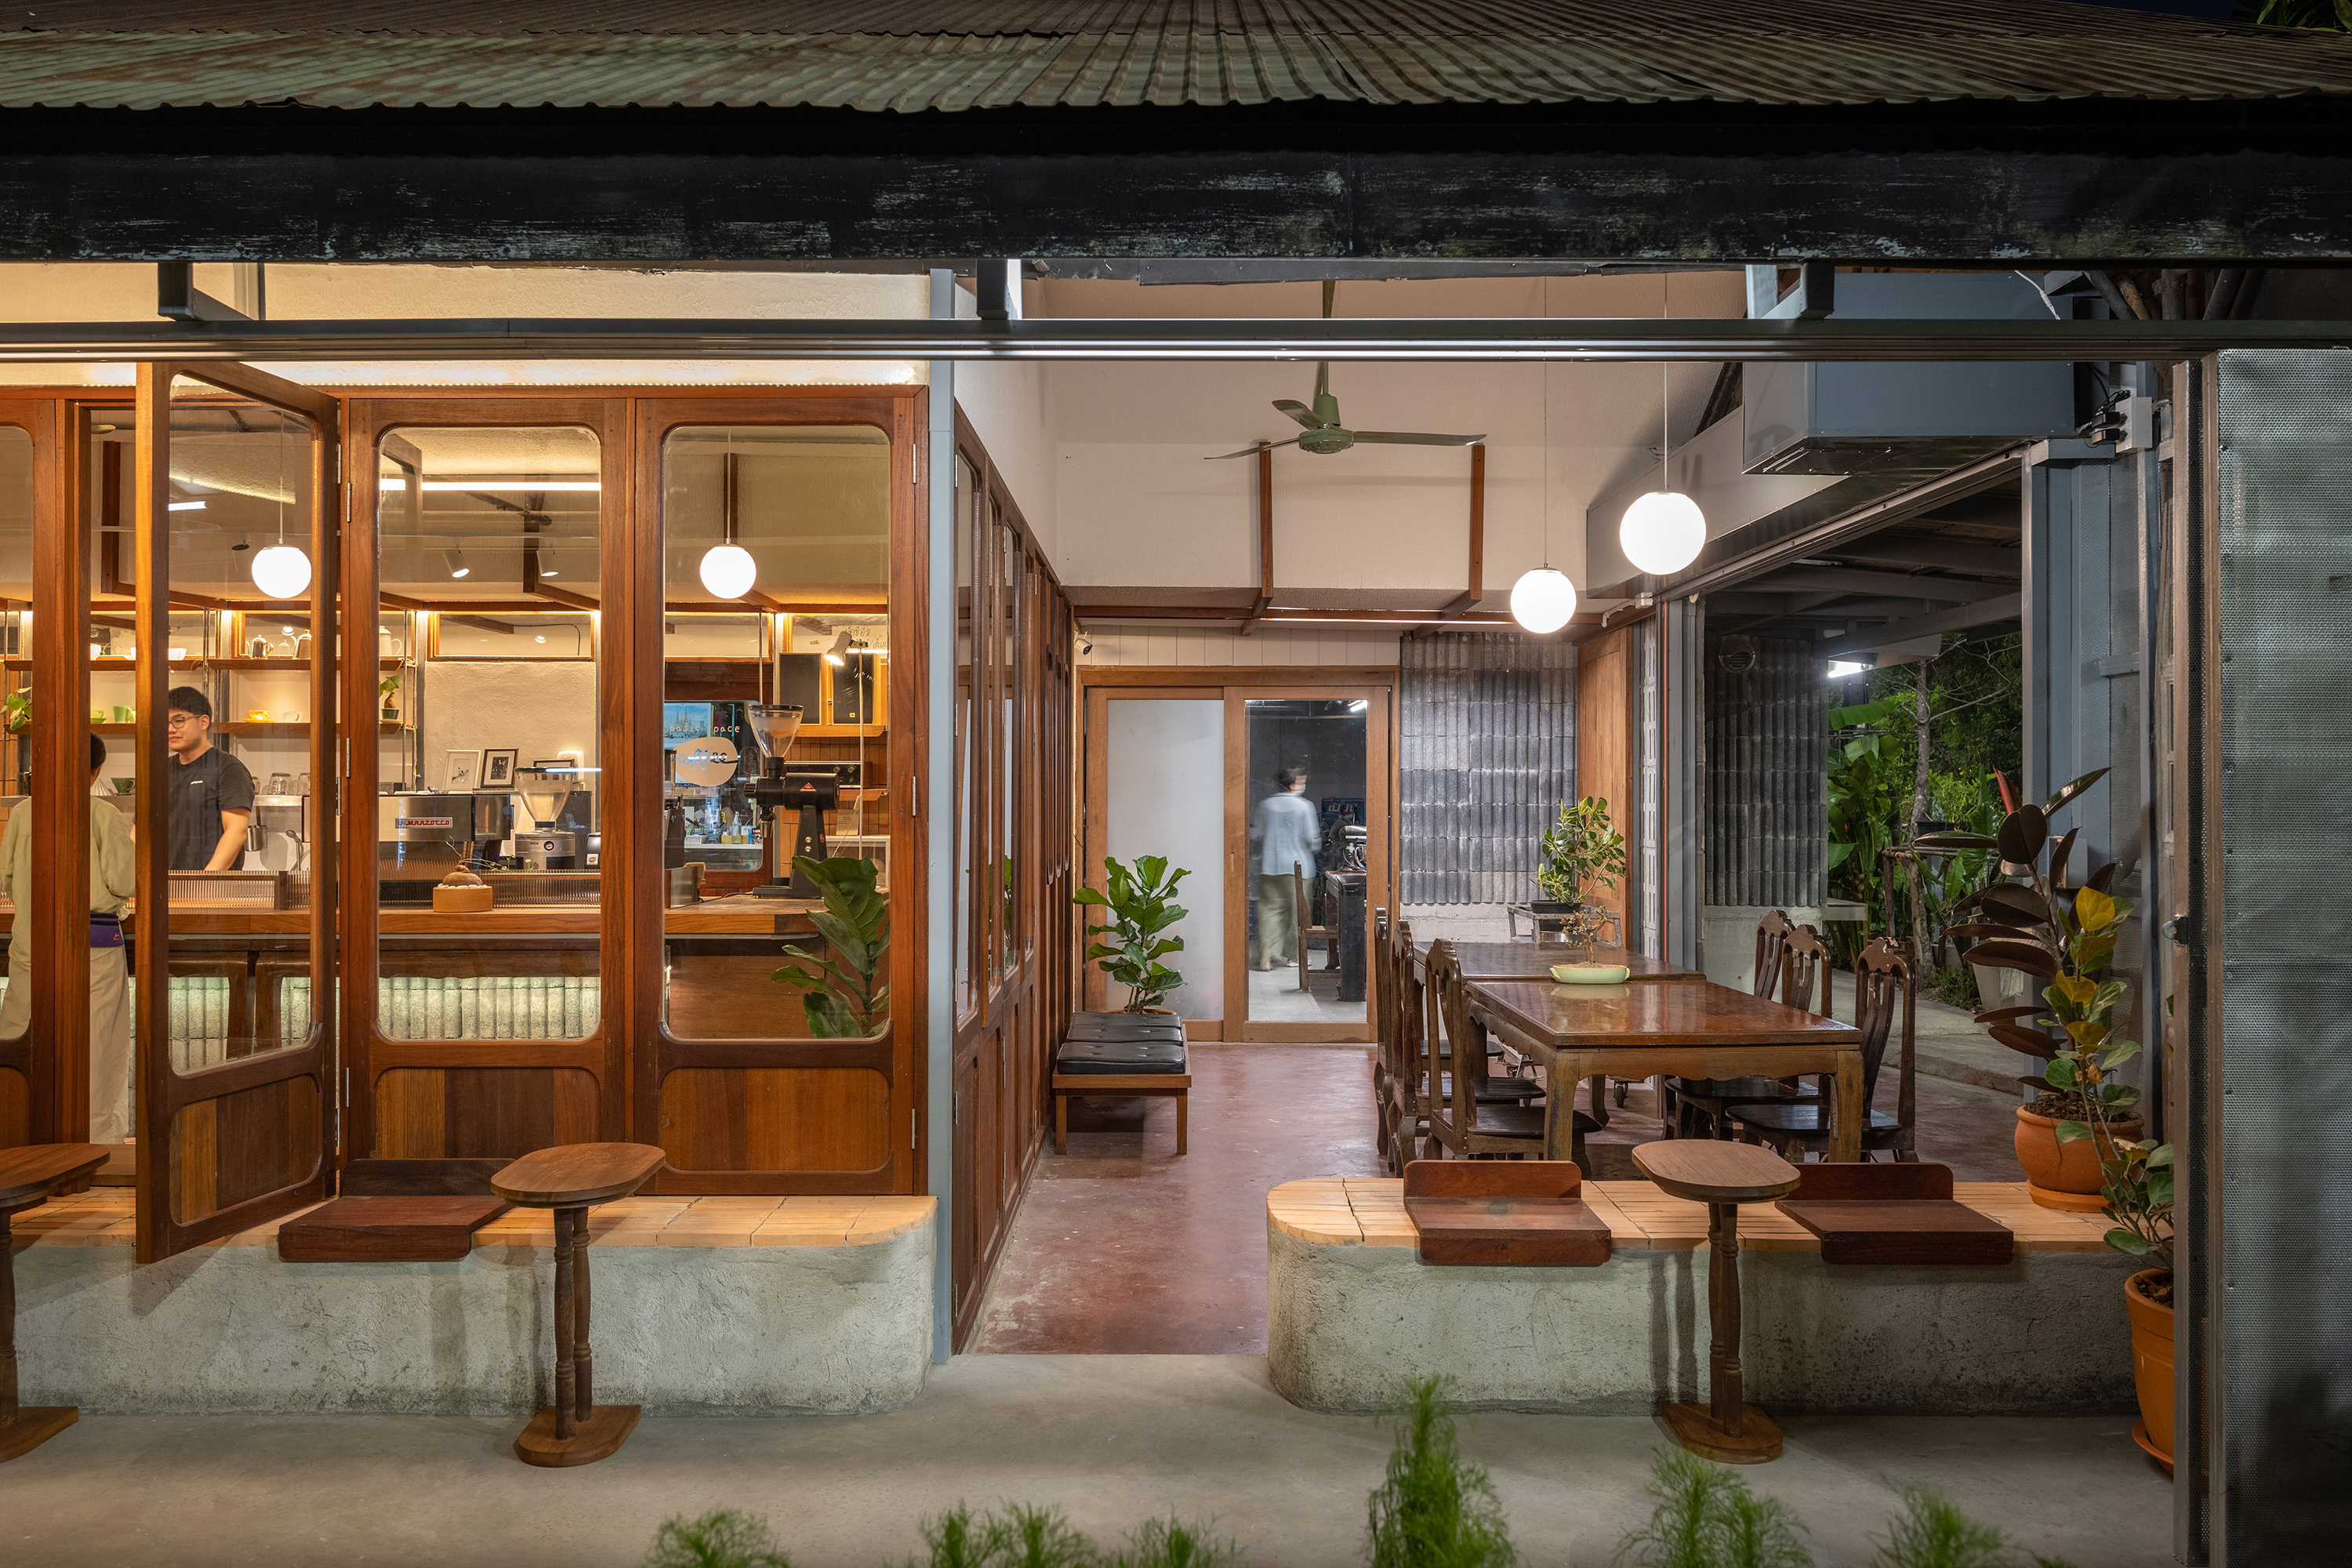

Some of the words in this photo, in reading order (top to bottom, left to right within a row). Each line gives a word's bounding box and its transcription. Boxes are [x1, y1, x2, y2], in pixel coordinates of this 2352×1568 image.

[670, 723, 700, 732] basic
[707, 725, 739, 735] space
[675, 749, 738, 771] coffee
